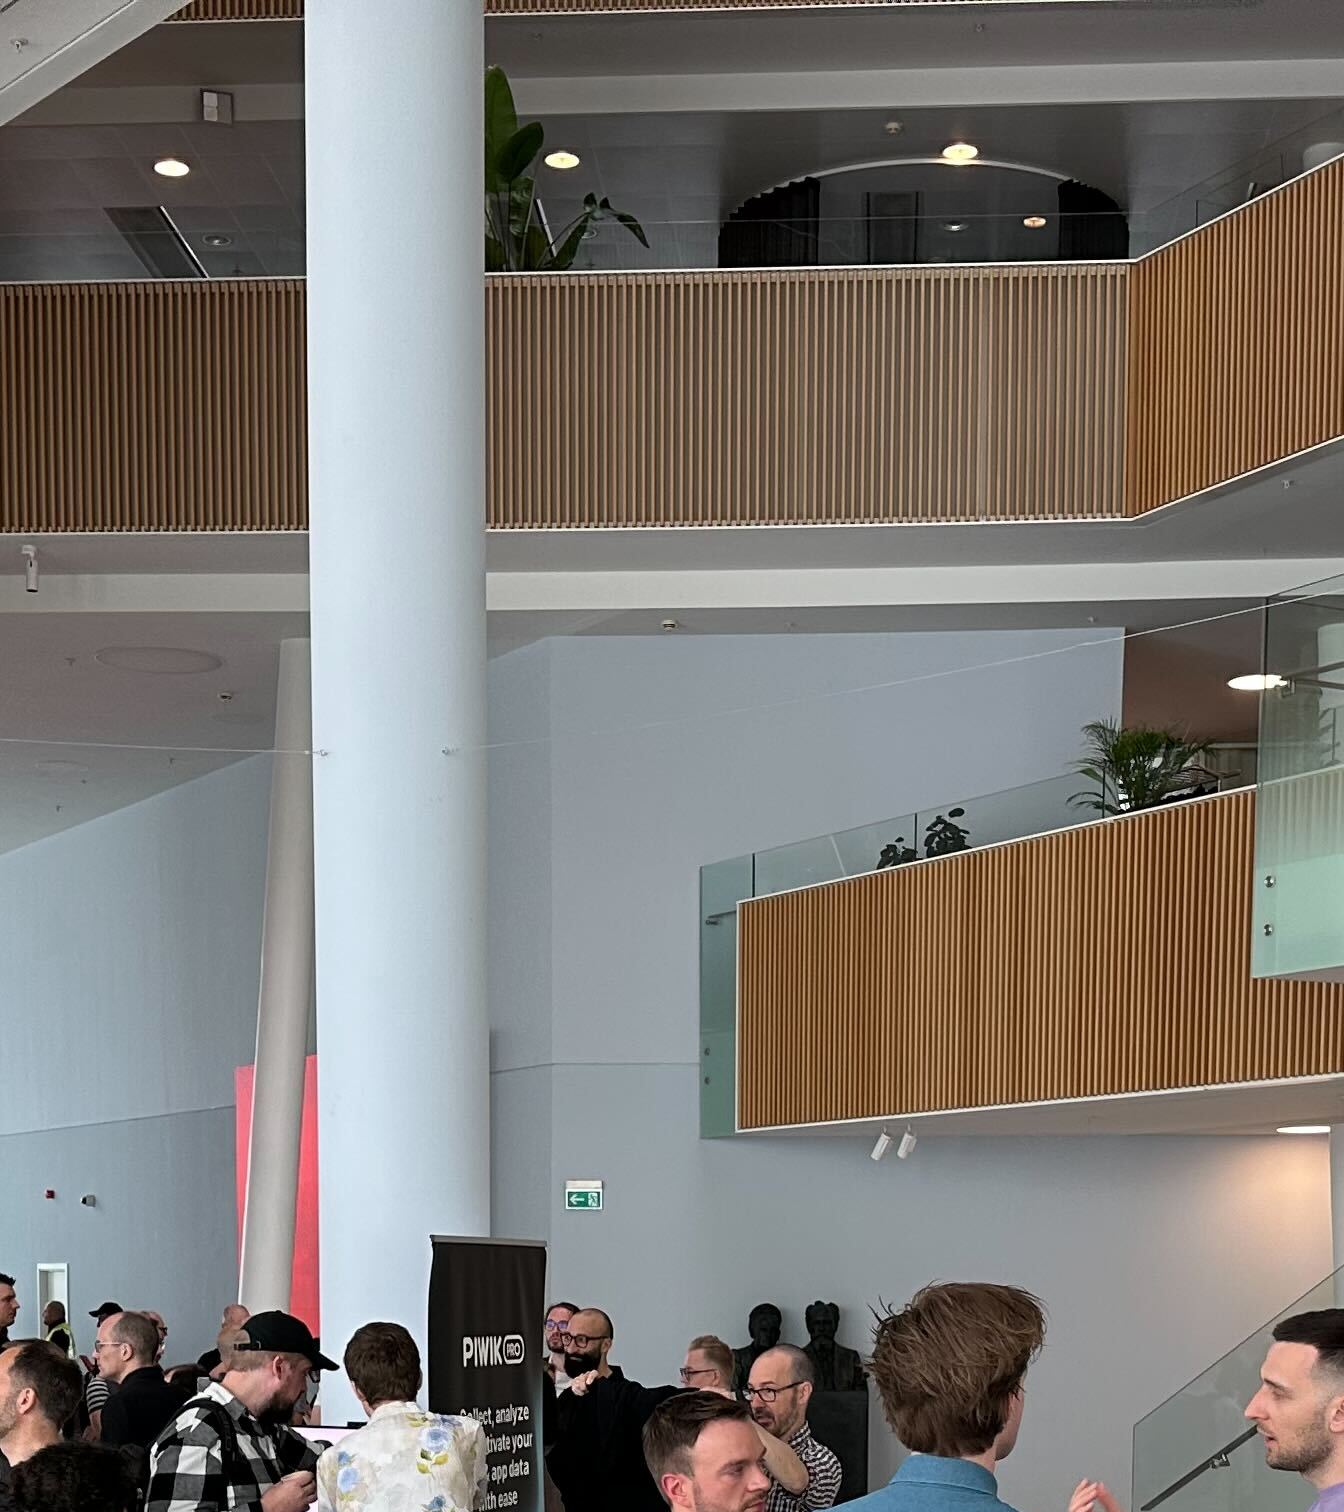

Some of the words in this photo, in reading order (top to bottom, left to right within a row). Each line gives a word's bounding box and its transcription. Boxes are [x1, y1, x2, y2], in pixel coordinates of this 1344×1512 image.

[462, 1335, 503, 1368] PIWIK
[496, 1403, 530, 1427] analyze
[486, 1433, 511, 1454] tivate
[512, 1433, 534, 1454] your
[491, 1464, 508, 1485] app
[509, 1459, 530, 1478] data
[498, 1490, 519, 1508] ease
